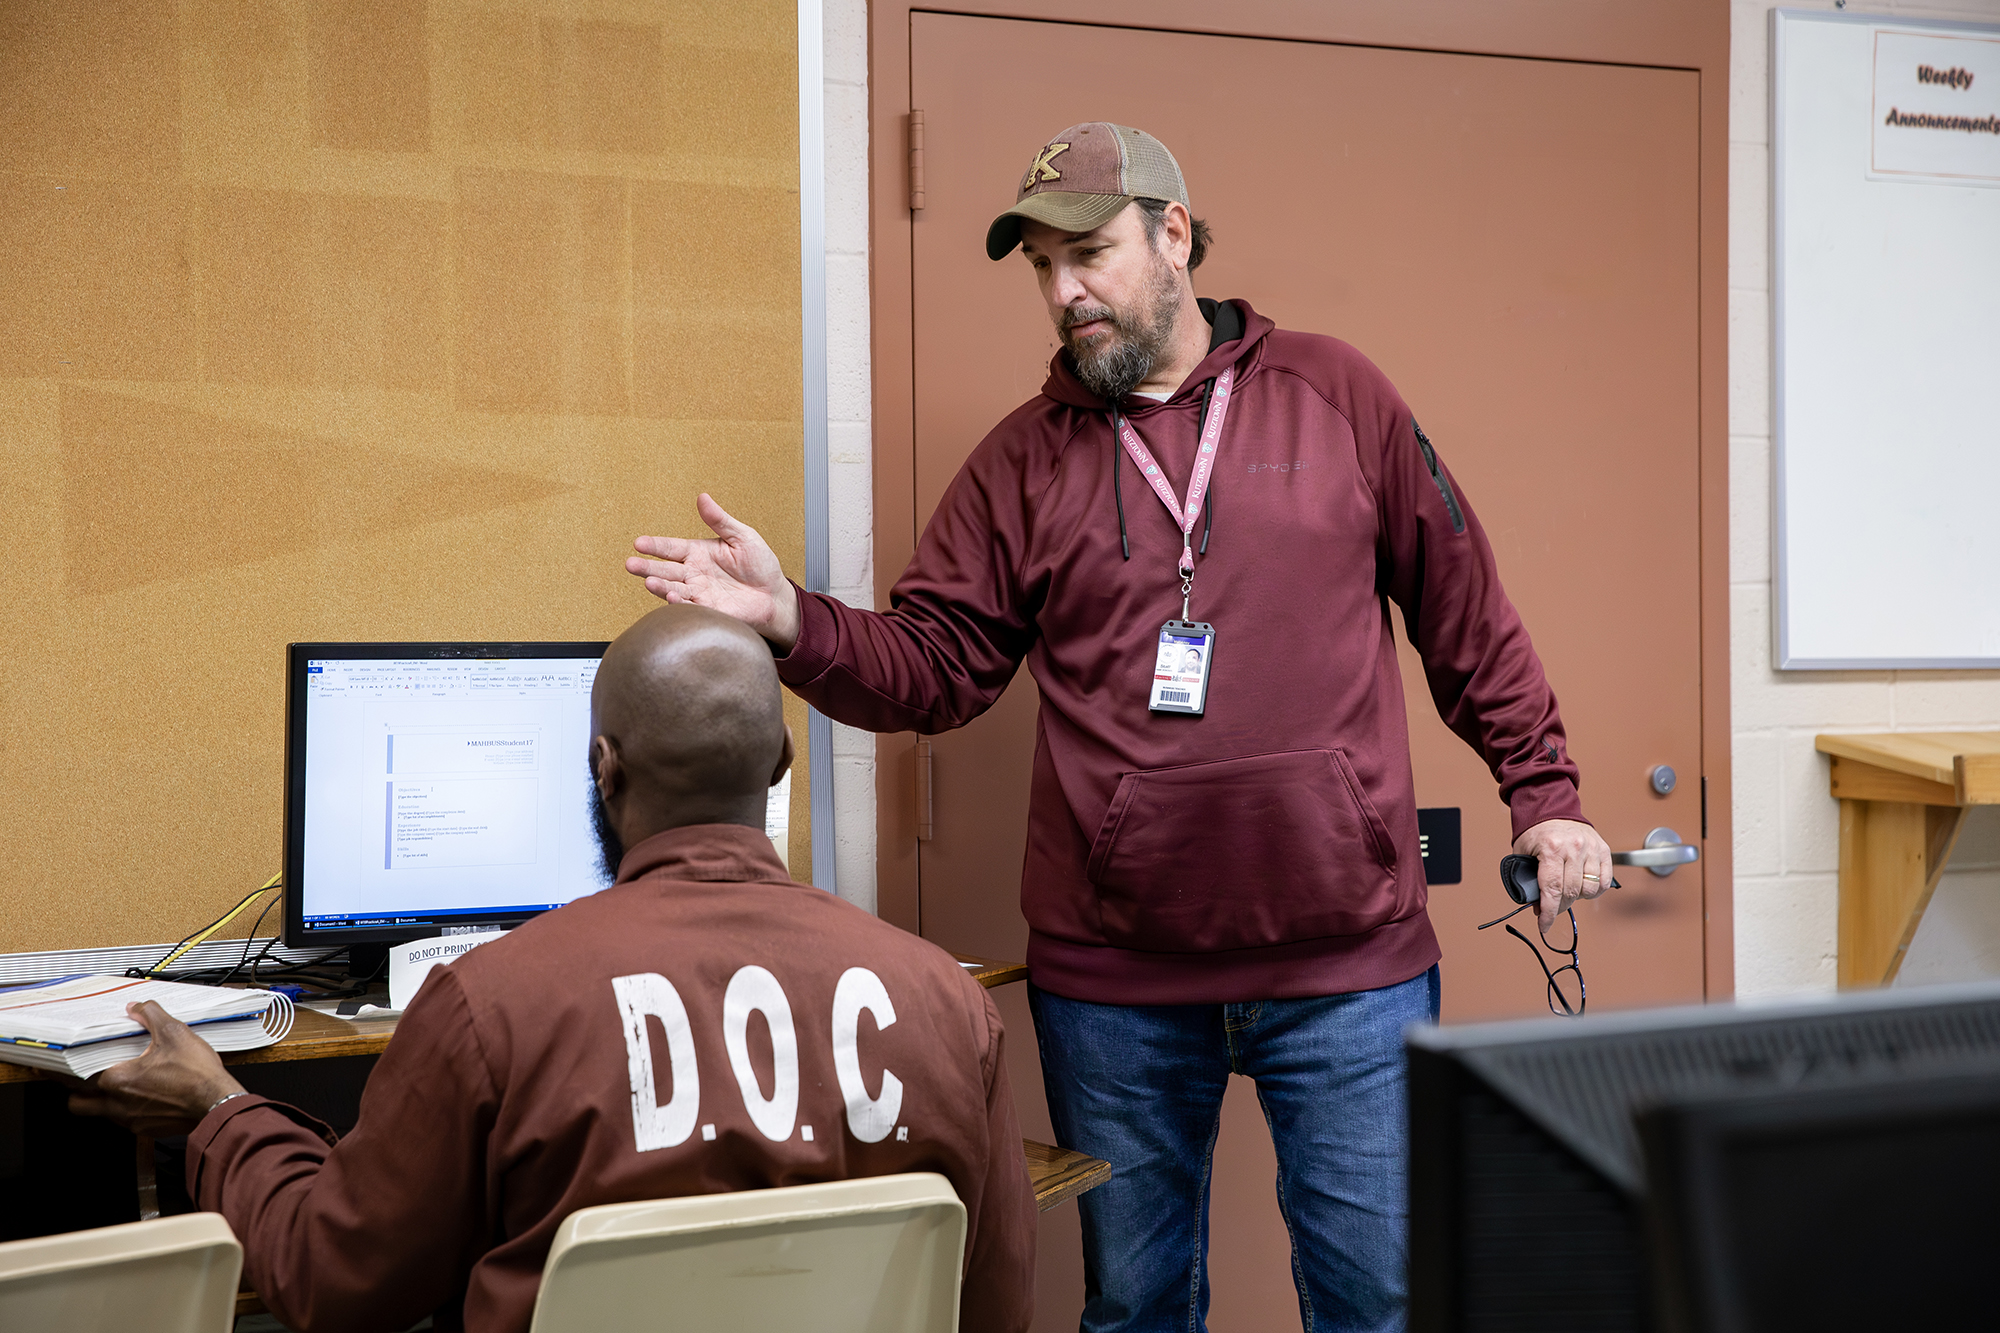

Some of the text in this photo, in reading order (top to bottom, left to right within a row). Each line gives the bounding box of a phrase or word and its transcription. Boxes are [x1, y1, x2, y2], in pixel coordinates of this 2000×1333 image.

[1917, 64, 1974, 91] Weekly
[1885, 105, 2000, 135] Announcements
[1024, 142, 1071, 192] K
[1220, 367, 1230, 384] KUTZ
[1207, 401, 1222, 439] KUTZTOWN
[1122, 429, 1149, 463] KUTZTOWN
[1191, 457, 1208, 499] KUTZTOWN
[409, 950, 421, 962] DO
[422, 946, 441, 959] NOT
[444, 943, 474, 955] PRINT
[611, 965, 909, 1153] D.O.C.
